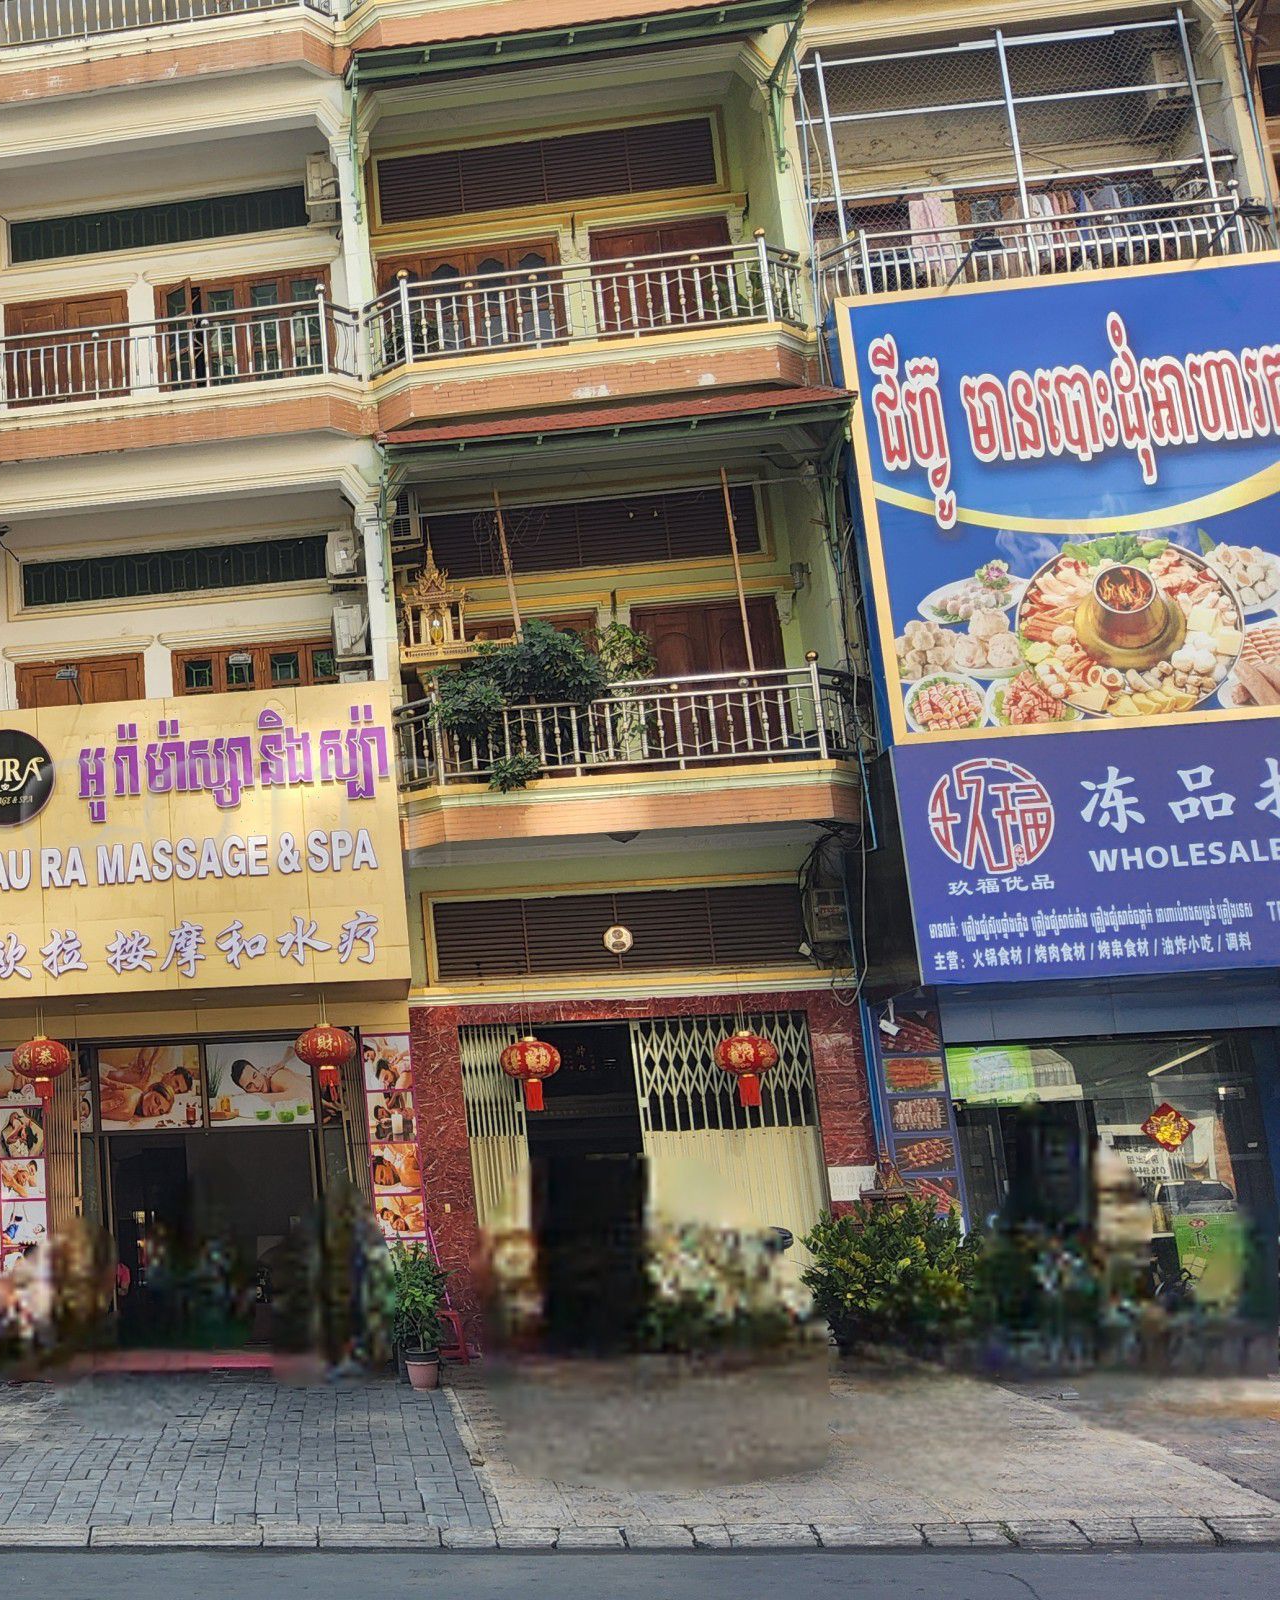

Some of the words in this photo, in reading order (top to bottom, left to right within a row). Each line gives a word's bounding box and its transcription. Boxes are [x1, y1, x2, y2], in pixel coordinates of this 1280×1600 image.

[97, 834, 269, 886] MASSAGE
[277, 832, 302, 873] &
[307, 828, 379, 872] SPA
[948, 874, 1055, 896] 玖福优品
[972, 946, 1022, 968] 火锅食材
[1034, 941, 1086, 963] 烤肉食材
[1098, 937, 1149, 959] 烤串食材
[1161, 934, 1214, 955] 油炸小吃
[1225, 931, 1252, 951] 调料
